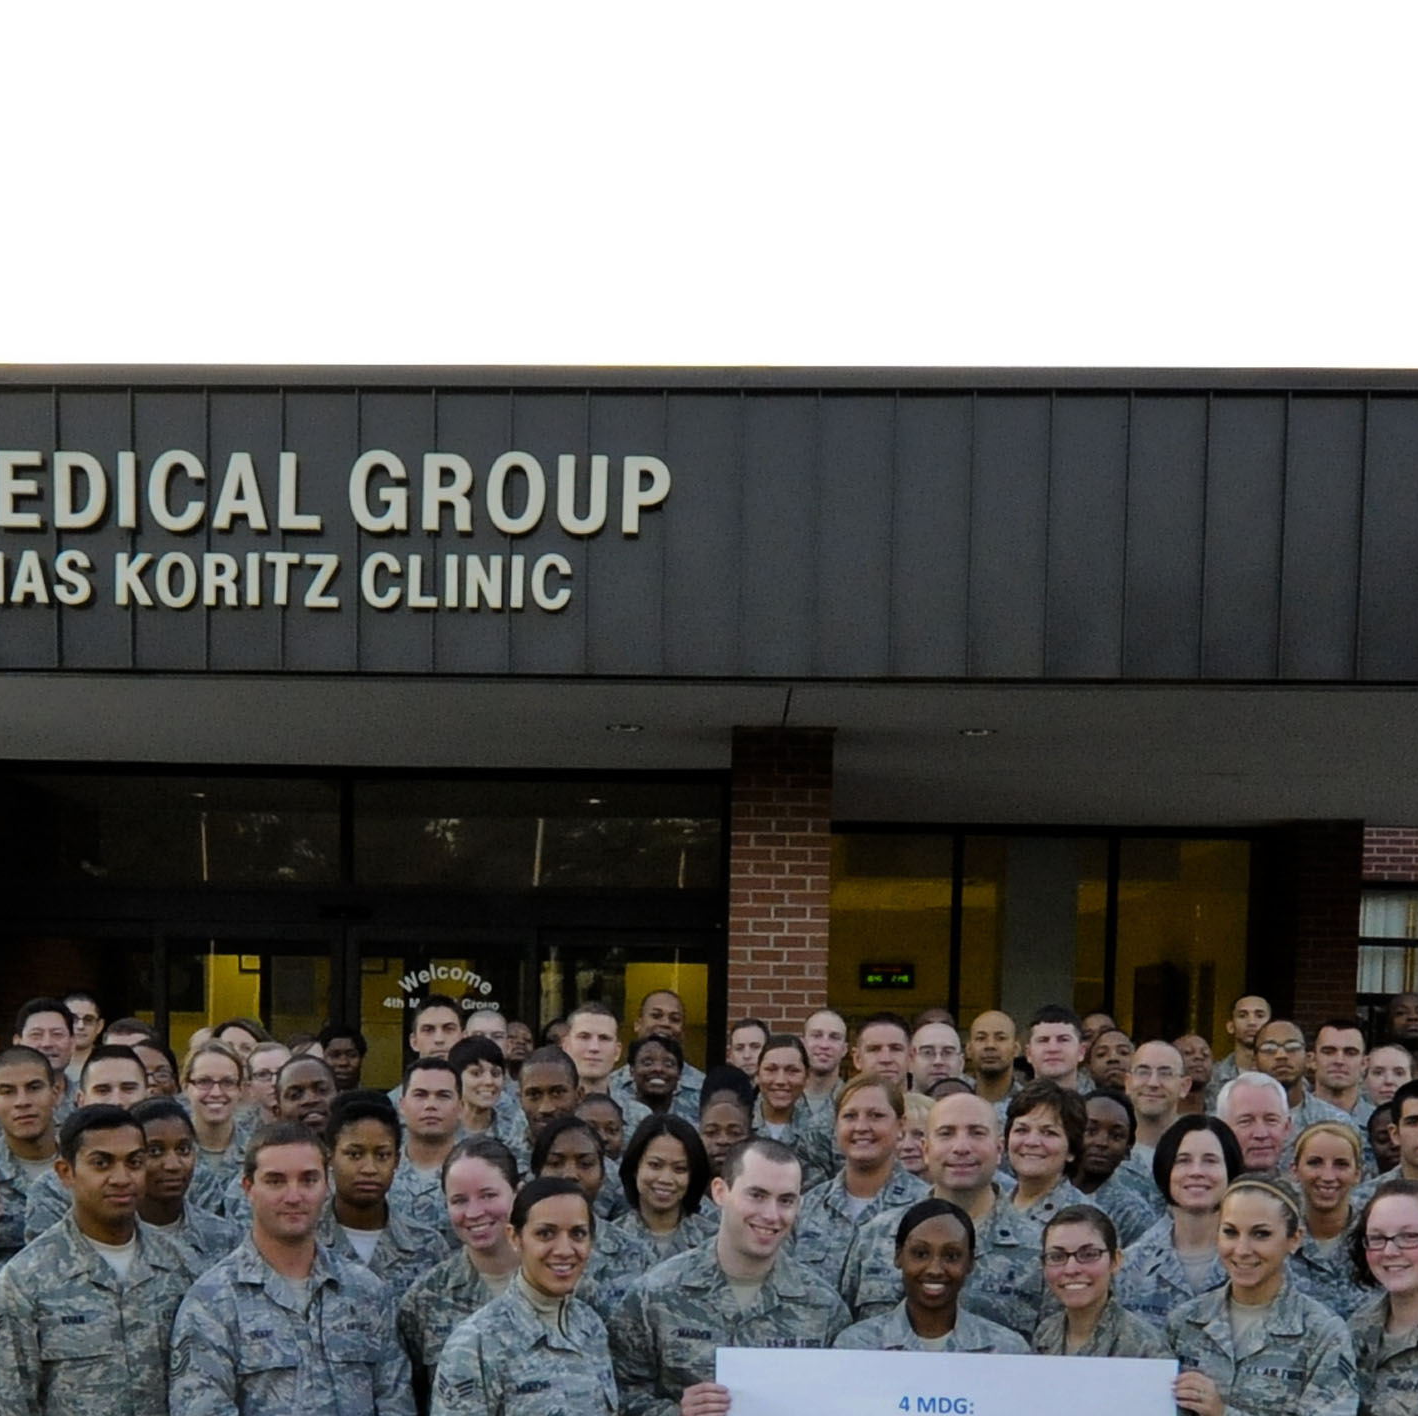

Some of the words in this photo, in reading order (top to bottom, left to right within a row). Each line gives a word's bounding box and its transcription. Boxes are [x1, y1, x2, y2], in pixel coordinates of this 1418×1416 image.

[348, 449, 671, 534] GROUP
[114, 551, 340, 608] KORITZ
[361, 552, 573, 610] CLINIC
[397, 964, 492, 995] Welcome
[382, 996, 405, 1010] 4th
[898, 1395, 911, 1413] 4
[916, 1396, 974, 1415] MDG:
